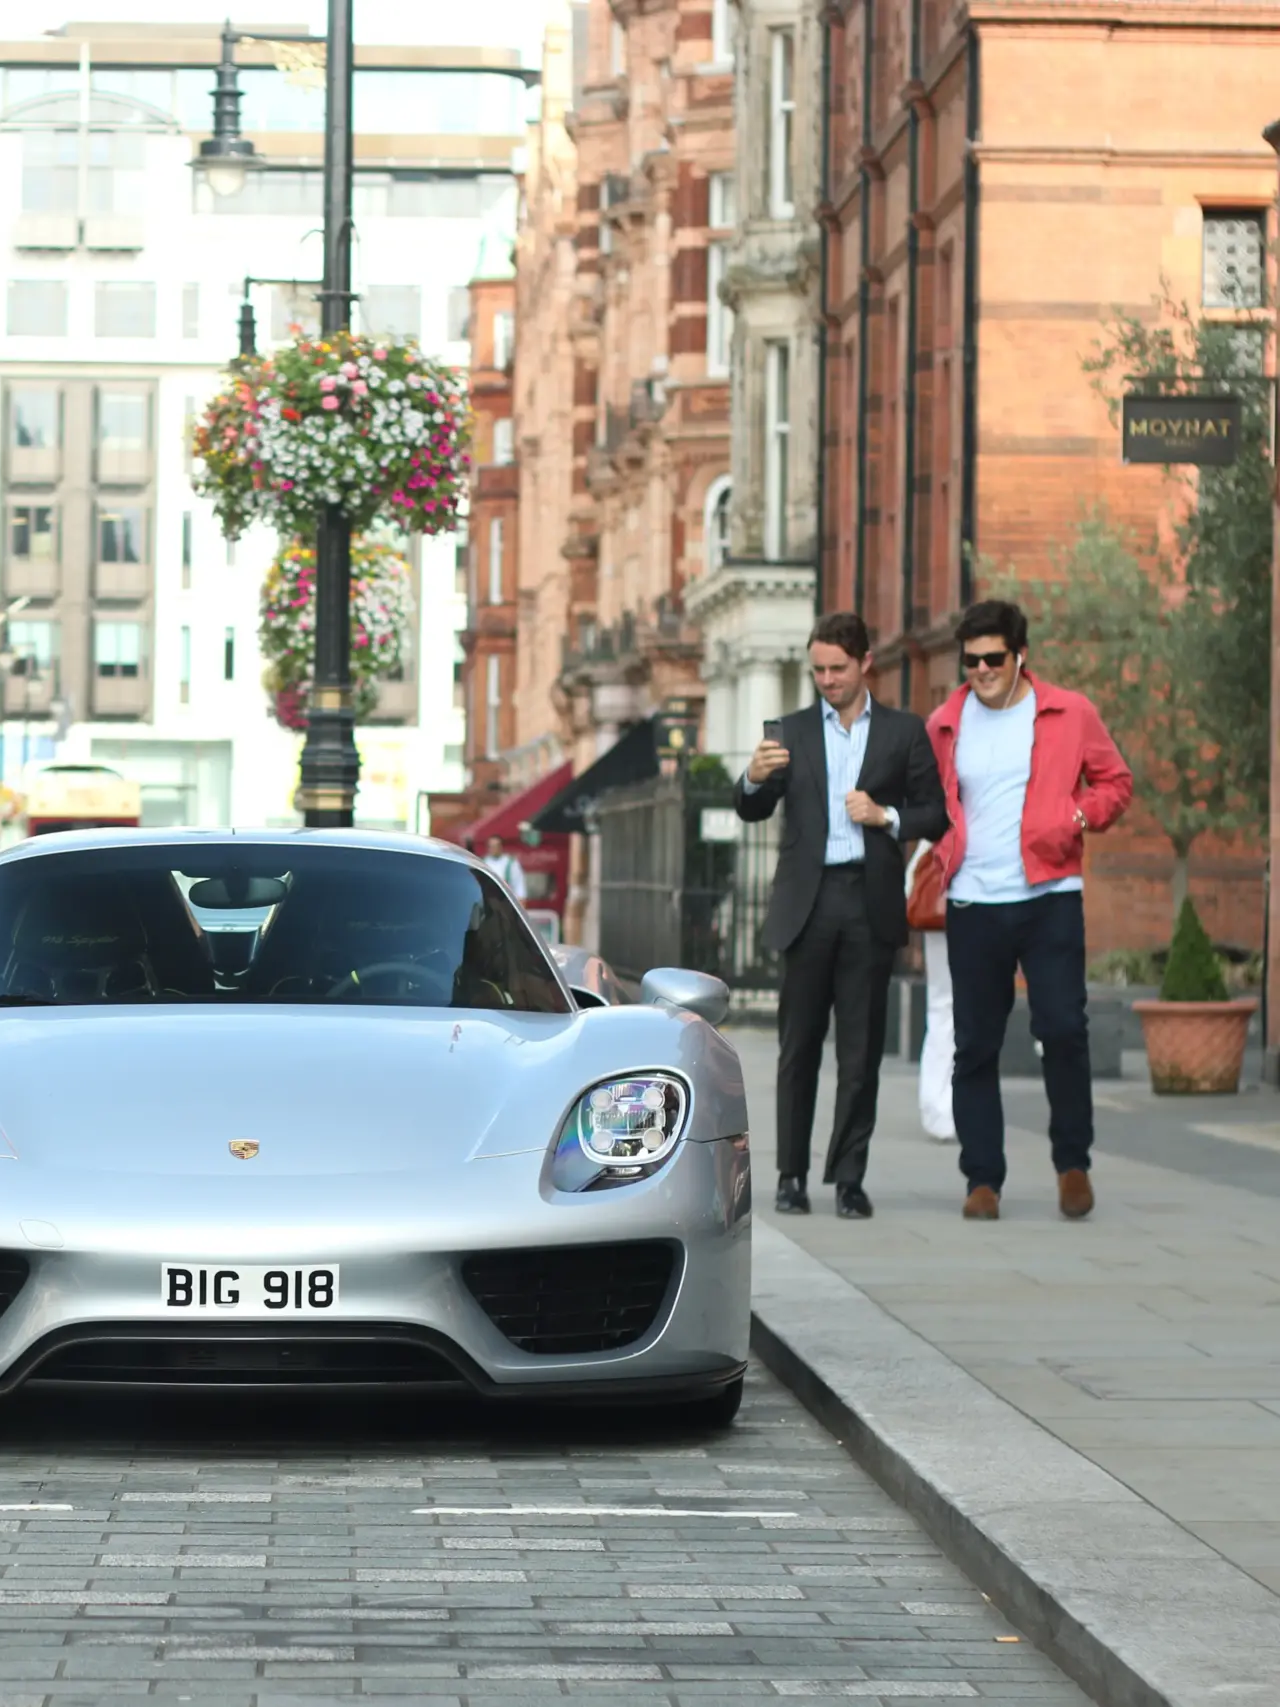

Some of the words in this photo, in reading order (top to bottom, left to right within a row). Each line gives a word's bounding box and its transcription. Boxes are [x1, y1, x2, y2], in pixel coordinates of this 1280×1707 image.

[1129, 418, 1232, 437] MOYNAT
[167, 1268, 239, 1308] BIG
[264, 1270, 333, 1309] 918
